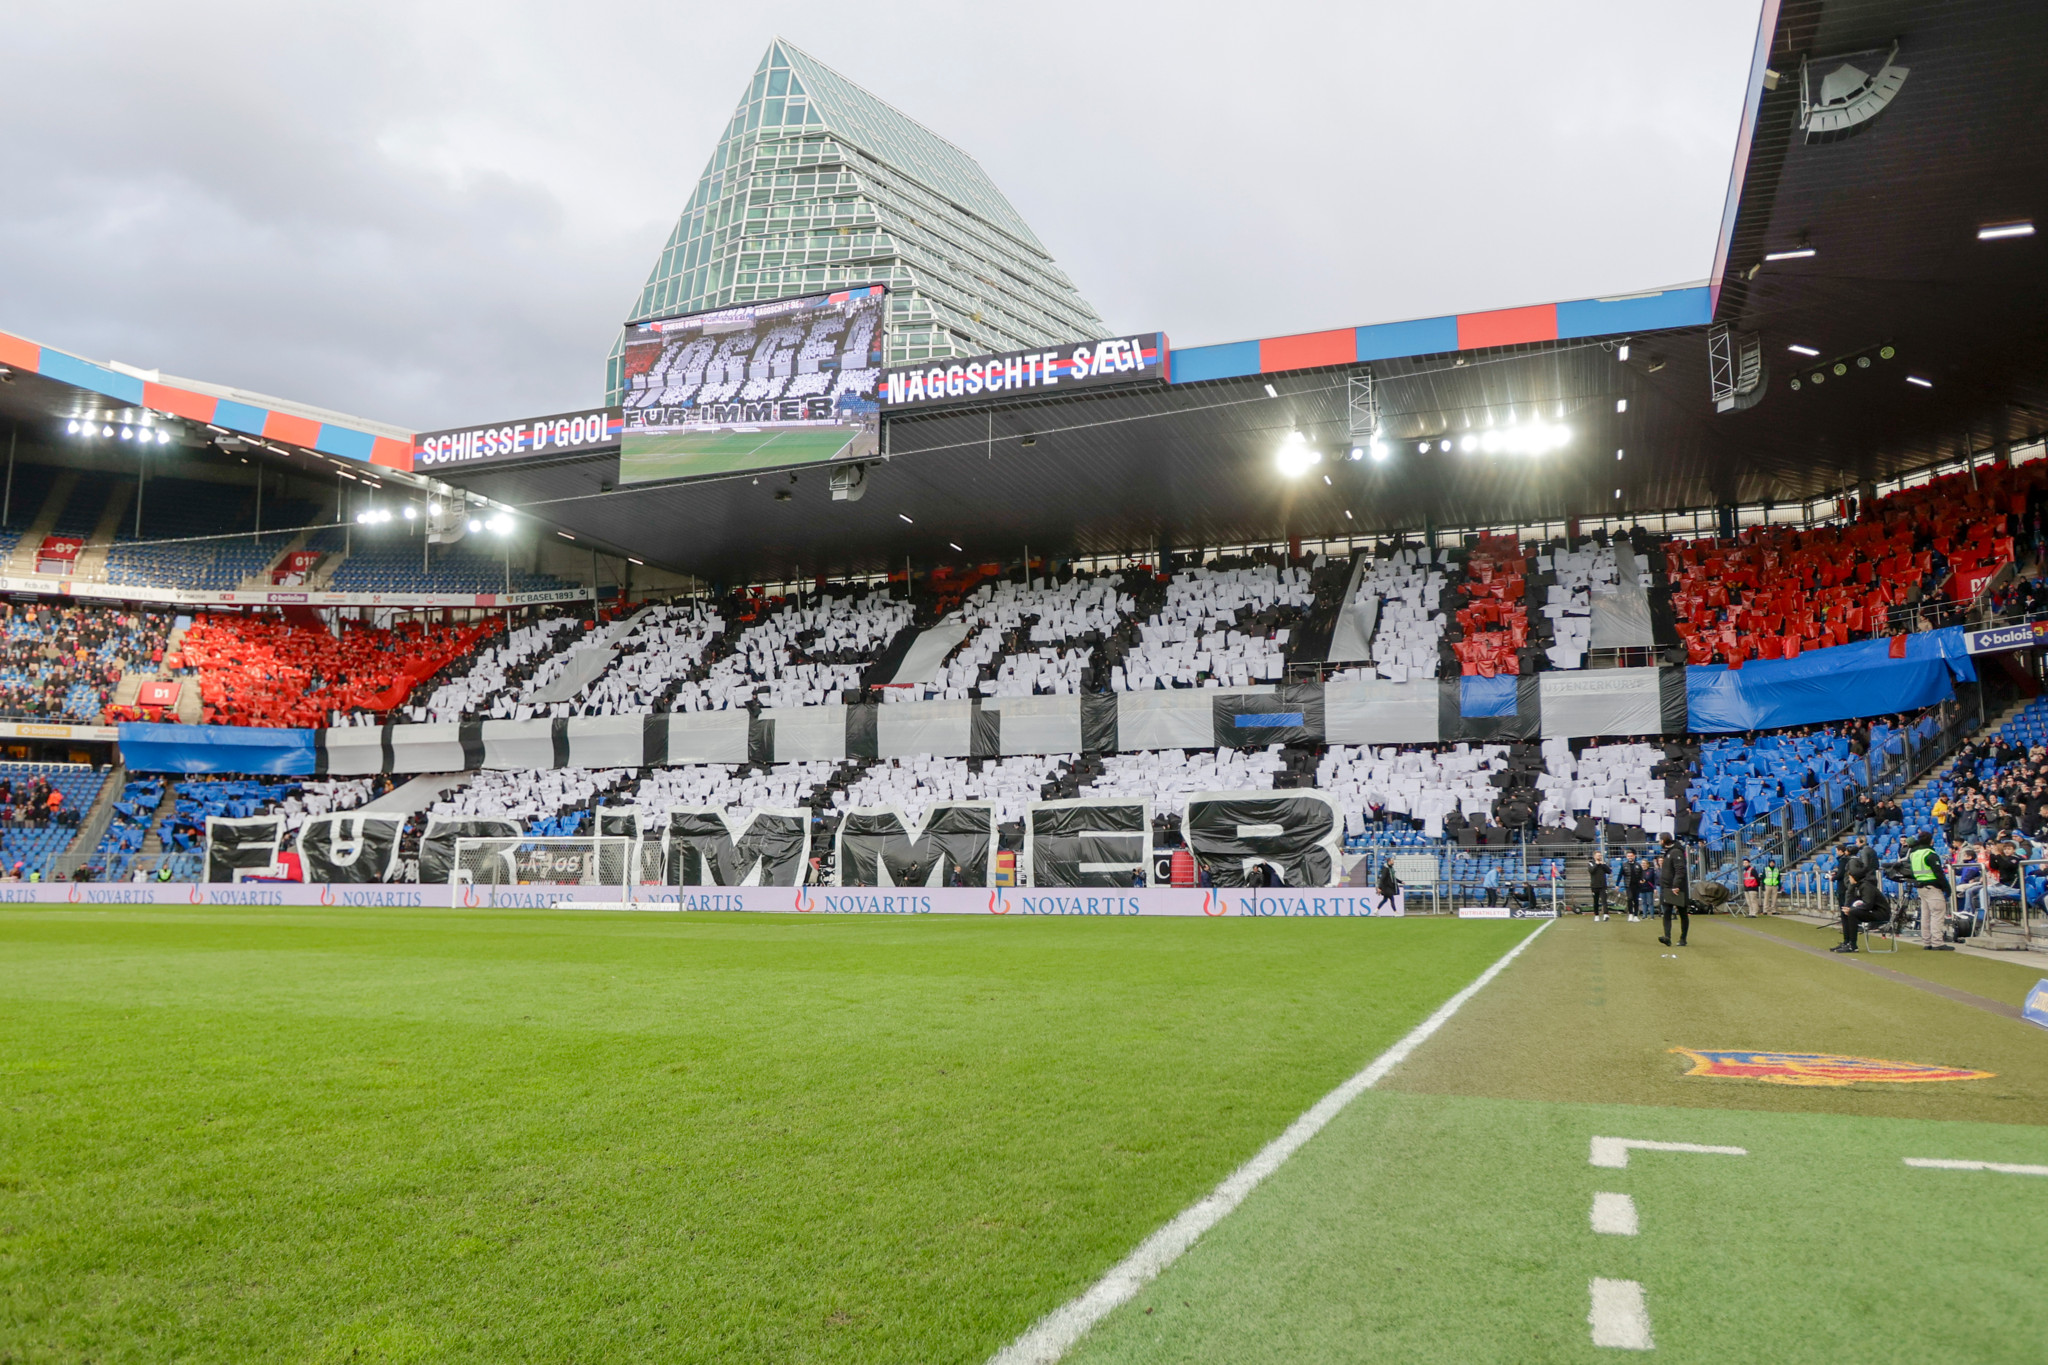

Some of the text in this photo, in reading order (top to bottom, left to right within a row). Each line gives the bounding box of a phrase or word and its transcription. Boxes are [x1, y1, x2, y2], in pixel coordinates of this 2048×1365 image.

[887, 352, 1058, 405] NÄGGSCHTE
[422, 412, 612, 464] SCHIESSE D'GOOL
[55, 543, 75, 554] G9
[515, 591, 574, 602] FC BASEL 1893
[154, 688, 170, 698] D1
[595, 788, 1343, 888] IMMER
[87, 890, 154, 904] NOVARTIS
[210, 890, 282, 905] NOVARTIS
[343, 891, 421, 907] NOVARTIS
[825, 895, 931, 913] NOVARTIS
[1022, 897, 1140, 916] NOVARTIS
[1240, 897, 1371, 916] NOVARTIS
